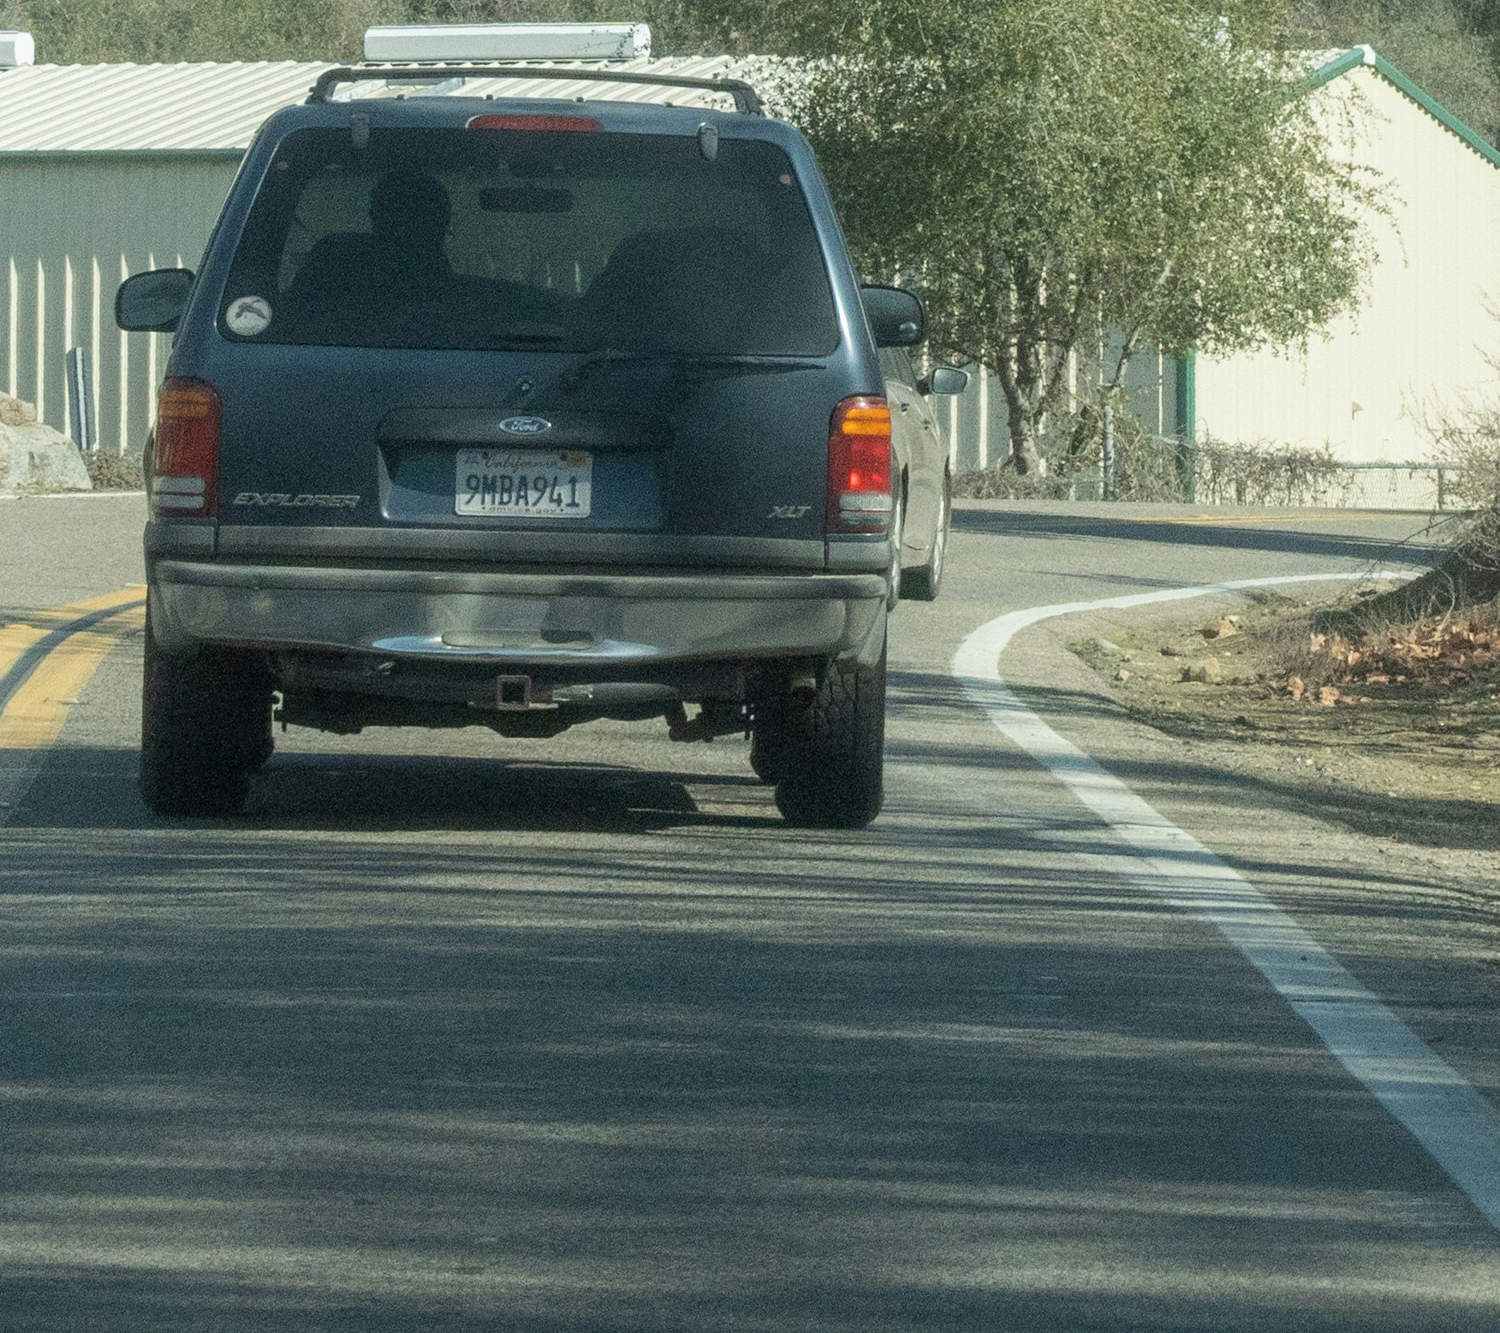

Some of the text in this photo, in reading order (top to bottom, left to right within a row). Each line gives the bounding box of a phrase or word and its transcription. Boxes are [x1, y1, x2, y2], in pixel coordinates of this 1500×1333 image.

[511, 418, 540, 432] Ford
[464, 473, 581, 508] 9MBA941
[232, 492, 361, 509] EXPLORER
[766, 504, 812, 519] XLT
